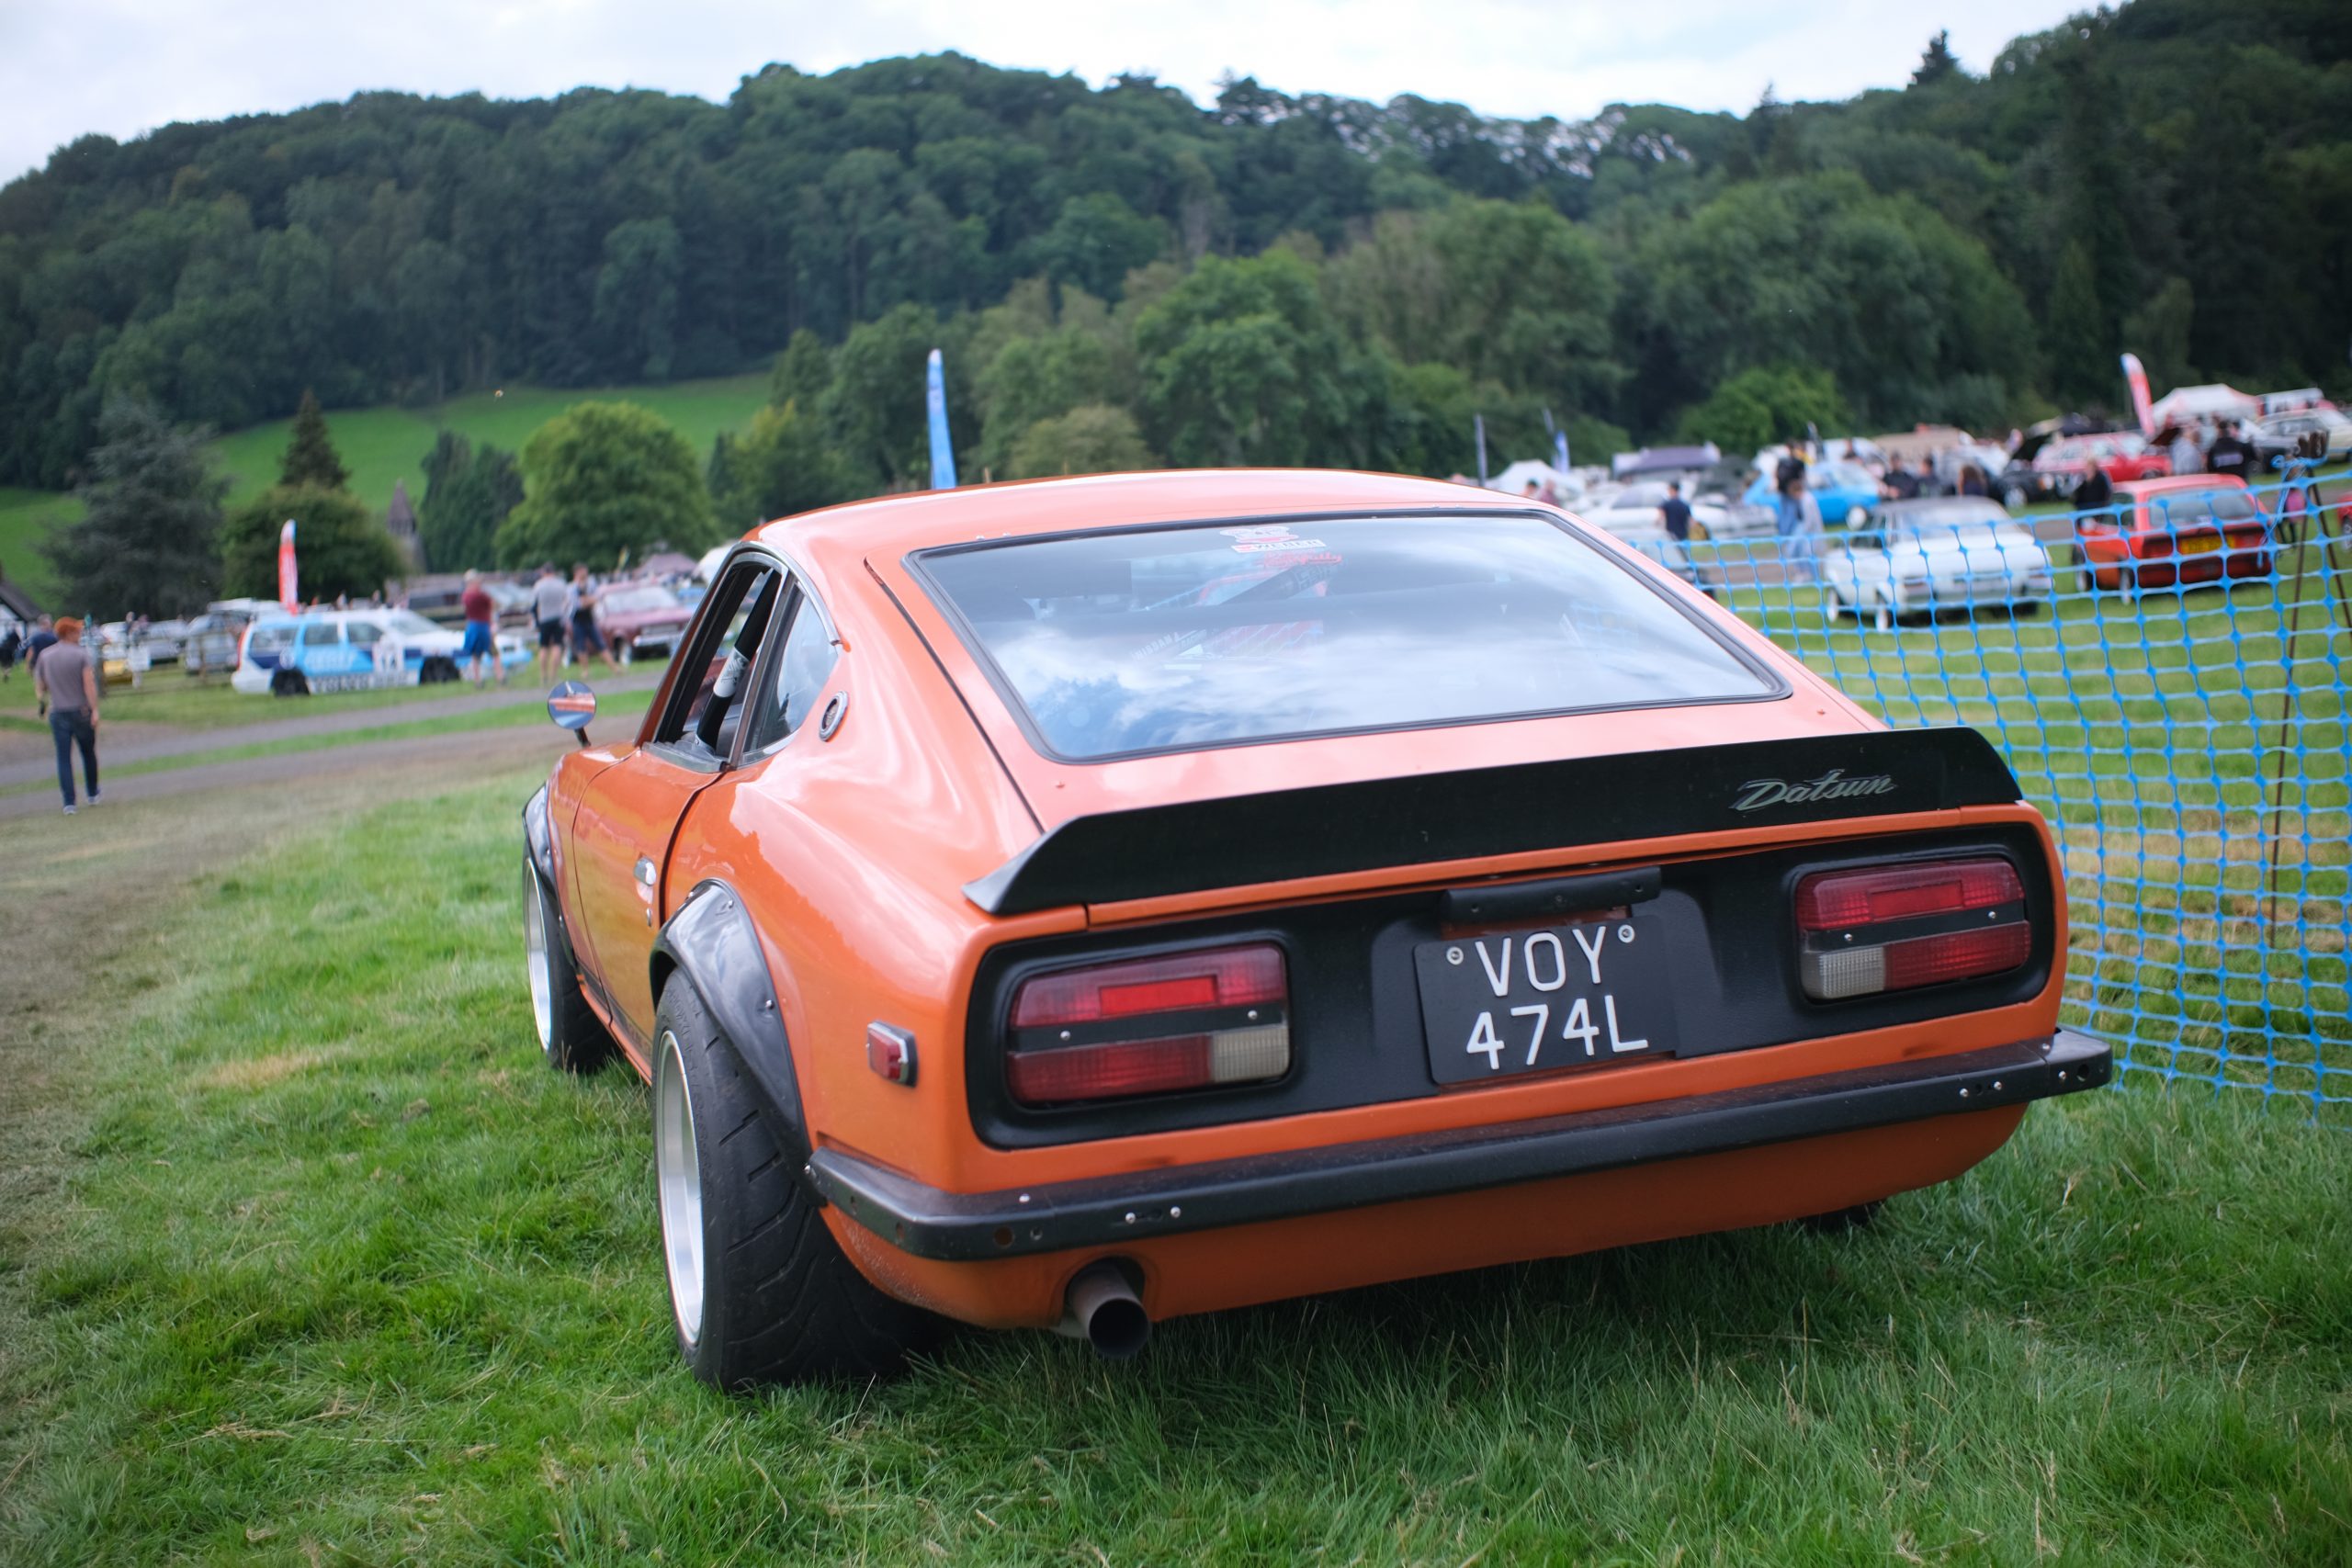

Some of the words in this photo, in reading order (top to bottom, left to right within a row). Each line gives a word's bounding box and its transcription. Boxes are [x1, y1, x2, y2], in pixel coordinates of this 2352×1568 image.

[1729, 769, 1897, 810] Datsun
[1475, 926, 1606, 997] VOY
[1466, 995, 1649, 1070] 474L
